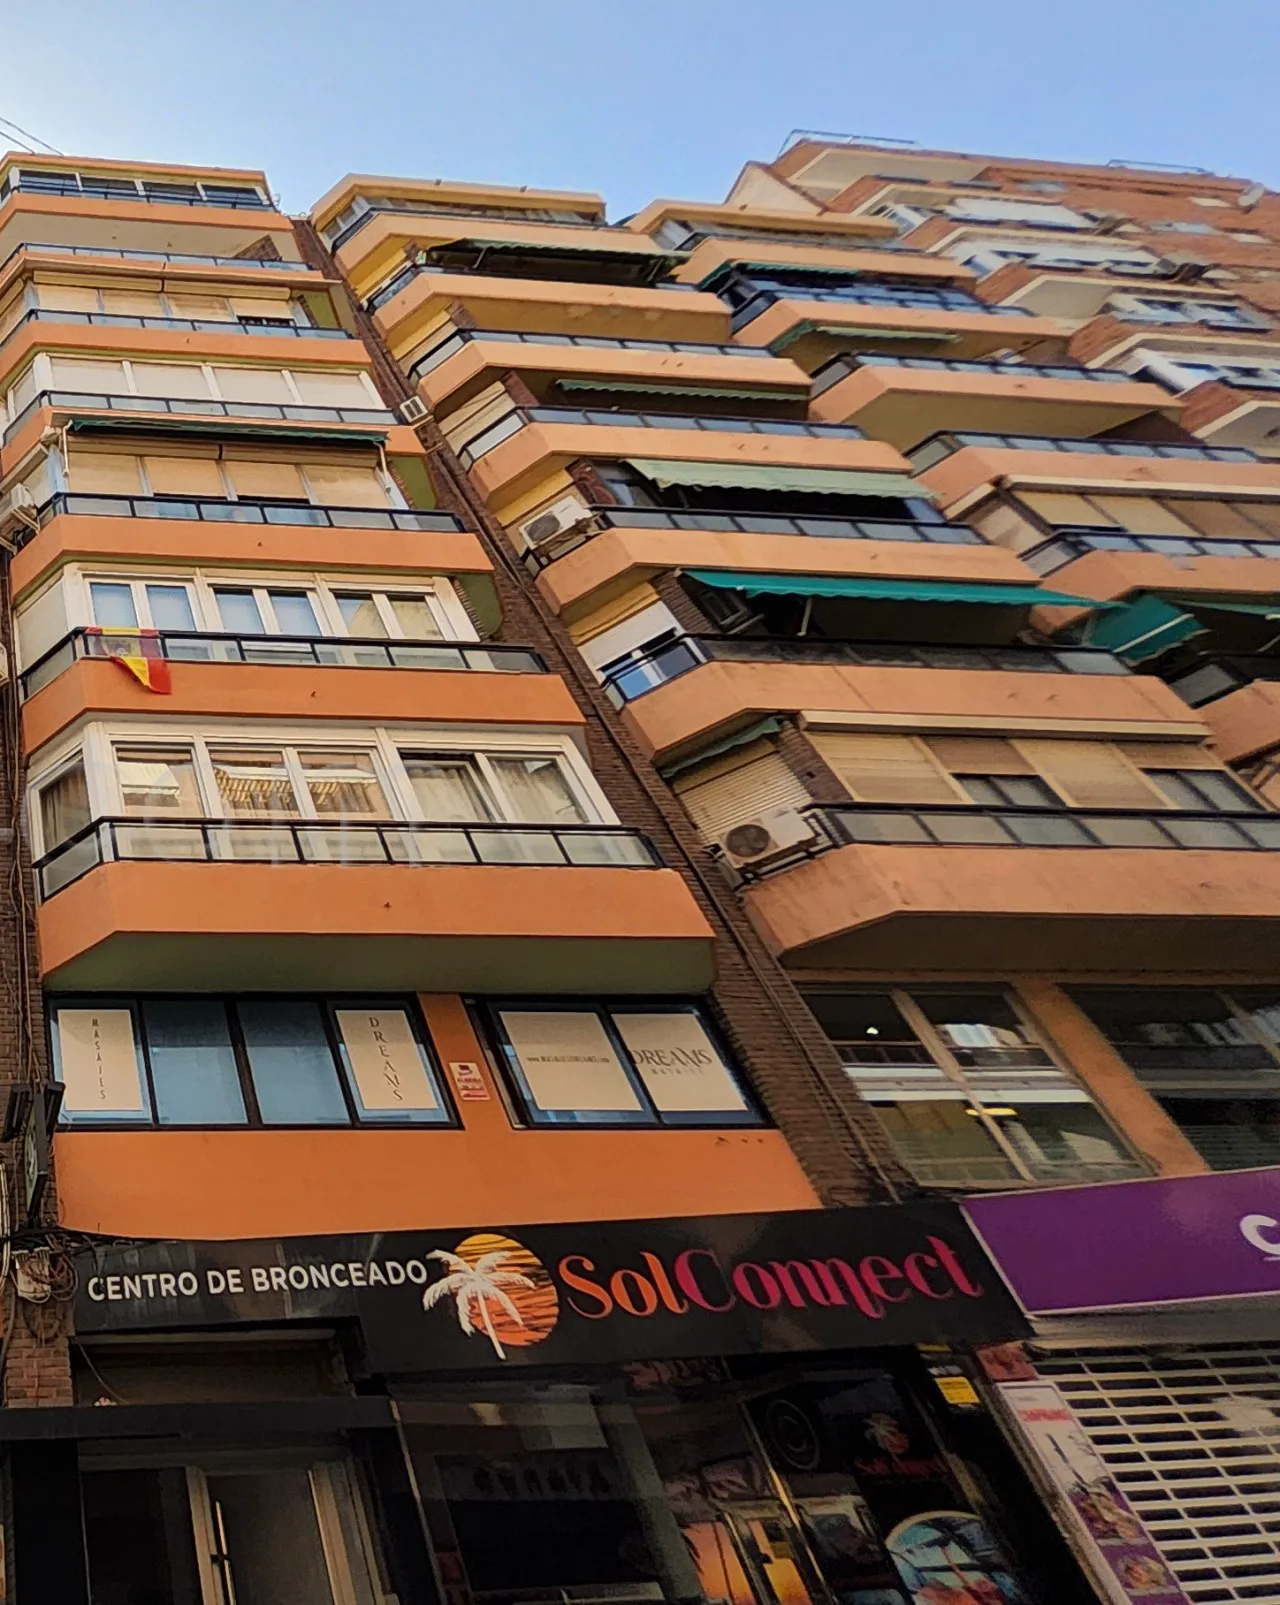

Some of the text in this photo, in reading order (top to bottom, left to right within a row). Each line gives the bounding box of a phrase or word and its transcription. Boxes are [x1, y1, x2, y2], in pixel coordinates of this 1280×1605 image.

[368, 1016, 404, 1102] DREAMS
[87, 1258, 428, 1302] CENTRO DE BRONCEADO
